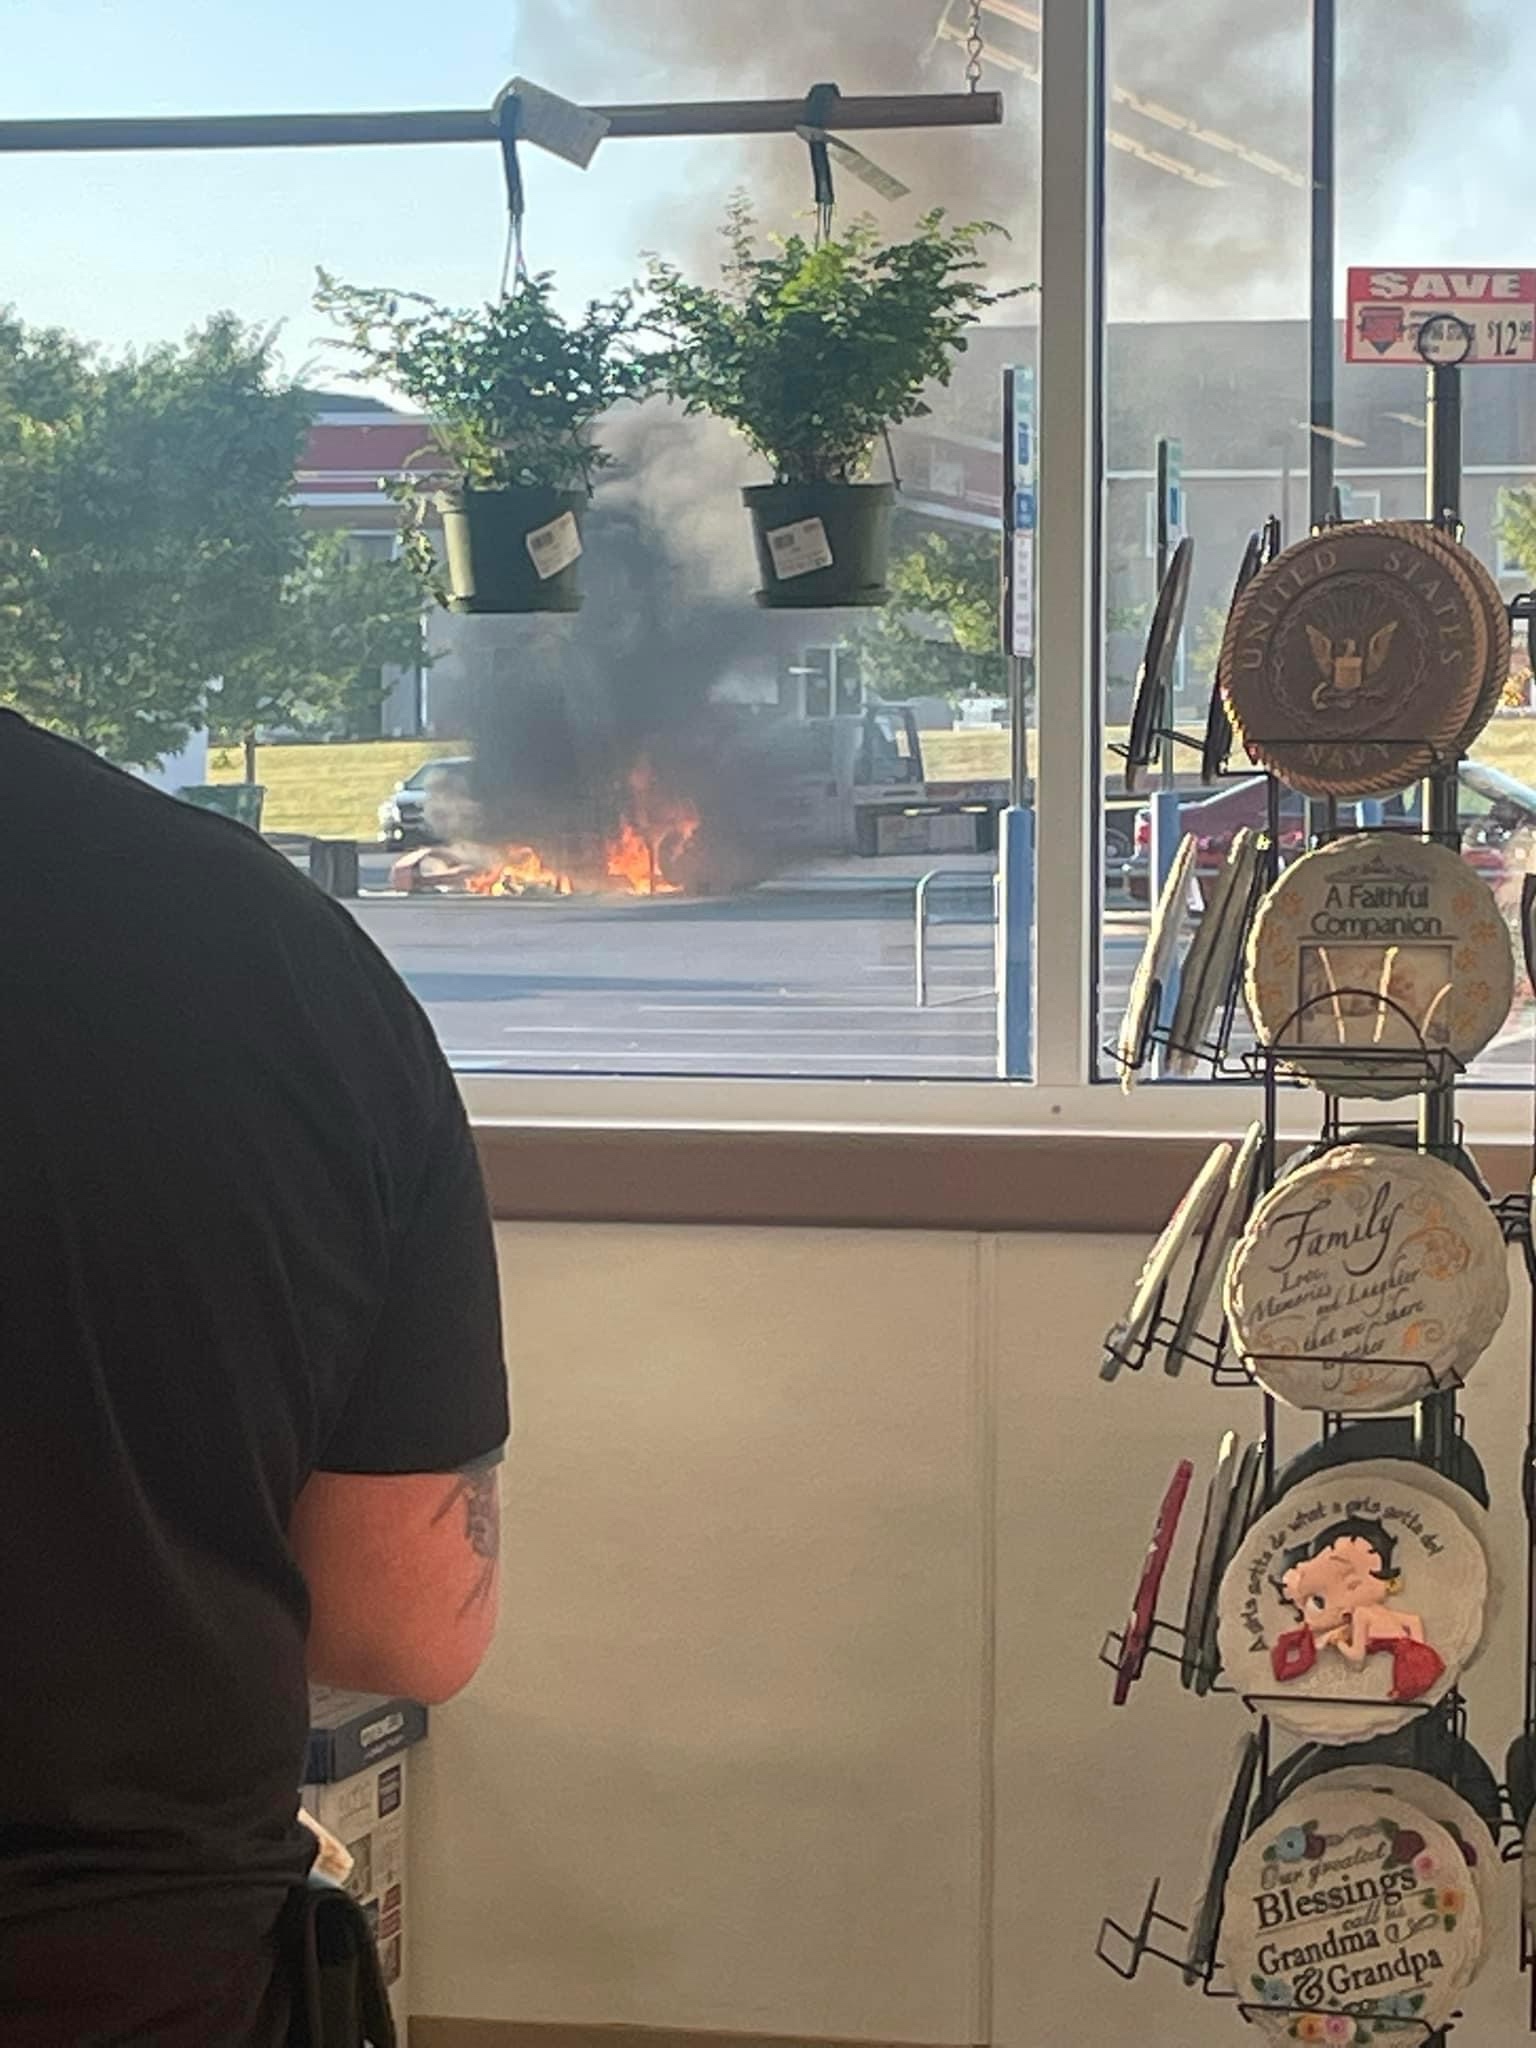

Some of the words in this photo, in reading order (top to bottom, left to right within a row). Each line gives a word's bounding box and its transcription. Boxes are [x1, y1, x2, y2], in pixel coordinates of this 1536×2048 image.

[1369, 272, 1521, 298] SAVE
[1243, 549, 1337, 669] UNITED
[1383, 552, 1463, 664] STATES
[1302, 741, 1390, 770] NAVY
[1325, 885, 1343, 909] A
[1350, 884, 1430, 910] Faithful
[1311, 912, 1442, 940] Companion
[1267, 1181, 1404, 1277] Family
[1250, 1285, 1332, 1322] Memories
[1249, 1635, 1269, 1652] A
[1288, 1500, 1327, 1531] what
[1261, 1862, 1303, 1890] Our
[1308, 1841, 1387, 1888] greatest
[1253, 1867, 1417, 1930] Blessings
[1342, 1899, 1380, 1931] call
[1258, 1929, 1381, 1975] Grandma
[1293, 1967, 1325, 2008] &
[1327, 1948, 1444, 1994] Grandpa
